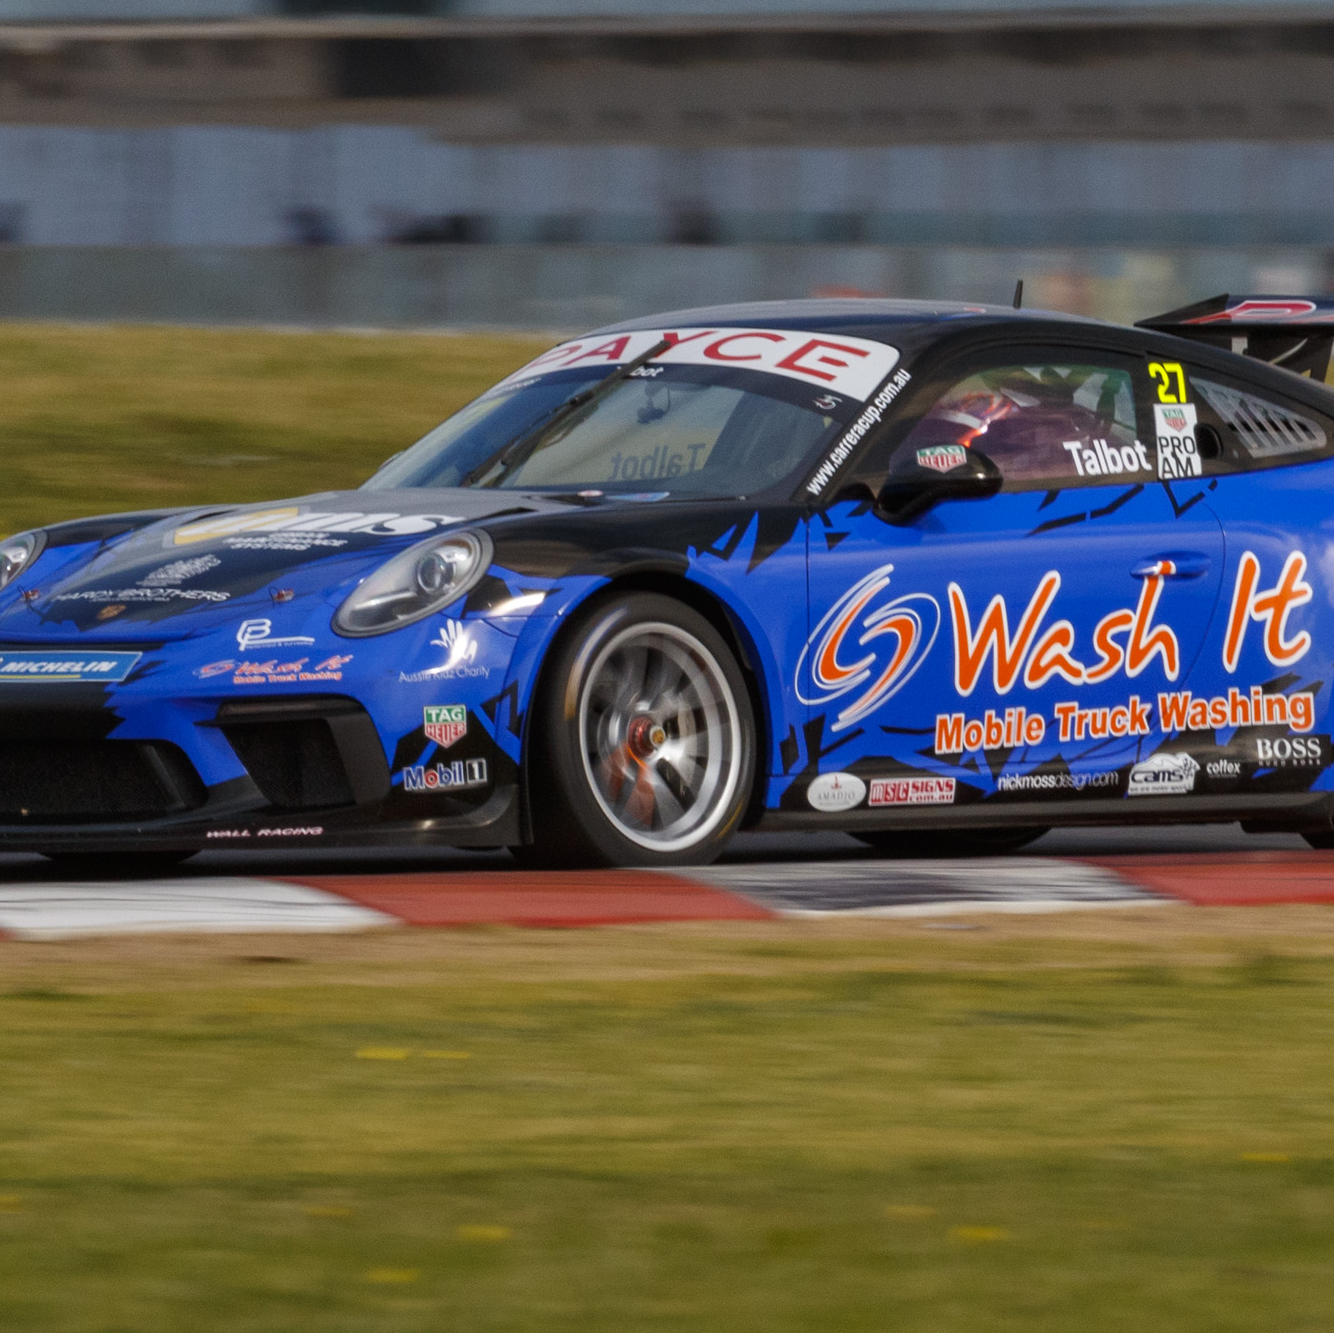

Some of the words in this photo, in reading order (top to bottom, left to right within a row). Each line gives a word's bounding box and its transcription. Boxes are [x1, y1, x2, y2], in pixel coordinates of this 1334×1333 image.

[1148, 362, 1187, 404] 27
[807, 368, 912, 496] www.carreracup.com.au
[919, 446, 963, 457] TAG
[1158, 436, 1197, 455] PRO
[1062, 439, 1153, 477] Talbot
[1162, 457, 1195, 479] AM
[947, 560, 1180, 698] Wash
[1222, 550, 1313, 674] It
[0, 661, 118, 673] MICHELIN
[456, 665, 491, 683] Charity
[428, 708, 464, 722] TAG
[935, 707, 1046, 755] Mobile
[1055, 694, 1153, 743] Truck
[1157, 685, 1315, 733] Washing
[427, 723, 465, 747] HEUER
[1256, 738, 1322, 760] BOSS
[403, 760, 465, 792] Mobil
[911, 779, 954, 794] SIGNS
[998, 770, 1119, 791] nickmossdesign.com
[207, 829, 251, 838] WALL
[257, 826, 324, 837] RACING
